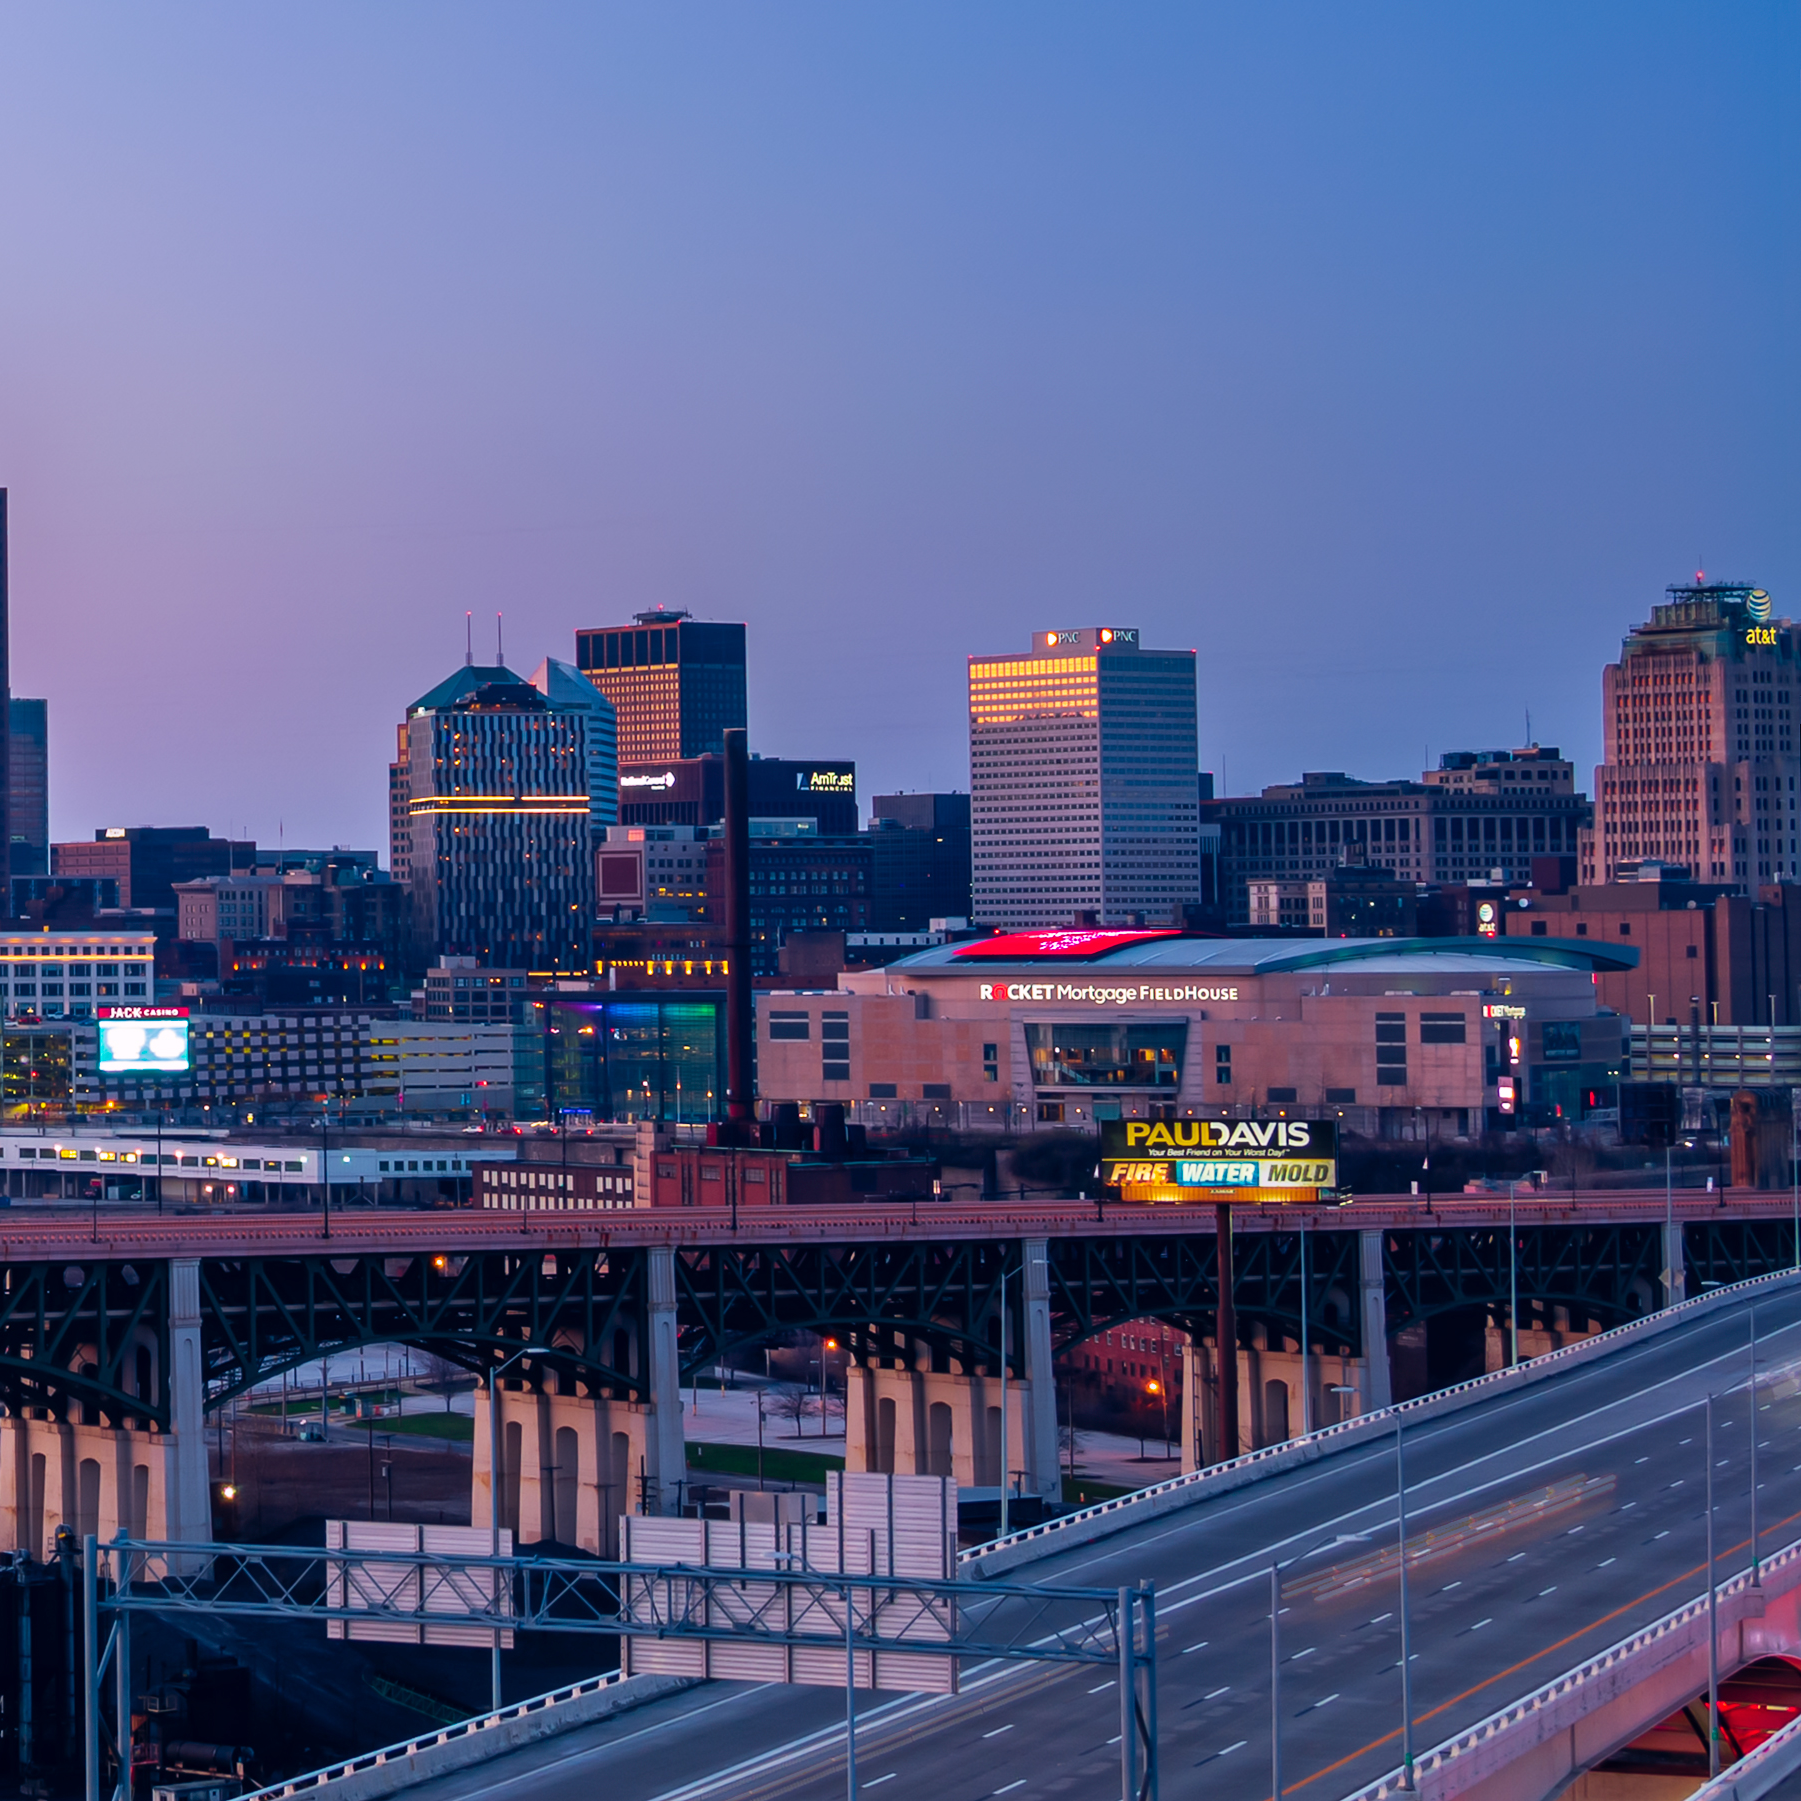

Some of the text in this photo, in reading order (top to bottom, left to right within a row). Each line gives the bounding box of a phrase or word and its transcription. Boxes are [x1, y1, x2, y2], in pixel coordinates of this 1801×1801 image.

[1059, 632, 1079, 643] PNC
[1113, 630, 1136, 642] PNC
[1746, 626, 1777, 645] at&t
[980, 983, 1054, 1001] ROCKET
[1057, 984, 1137, 1005] Mortgage
[110, 1007, 179, 1019] JACK CASINO
[1148, 1148, 1165, 1157] Your
[1167, 1148, 1184, 1157] Best
[1186, 1148, 1211, 1157] Friend
[1224, 1148, 1242, 1157] Your
[1244, 1148, 1266, 1157] Worst
[1111, 1163, 1329, 1183] FIRE WATER MOLD
